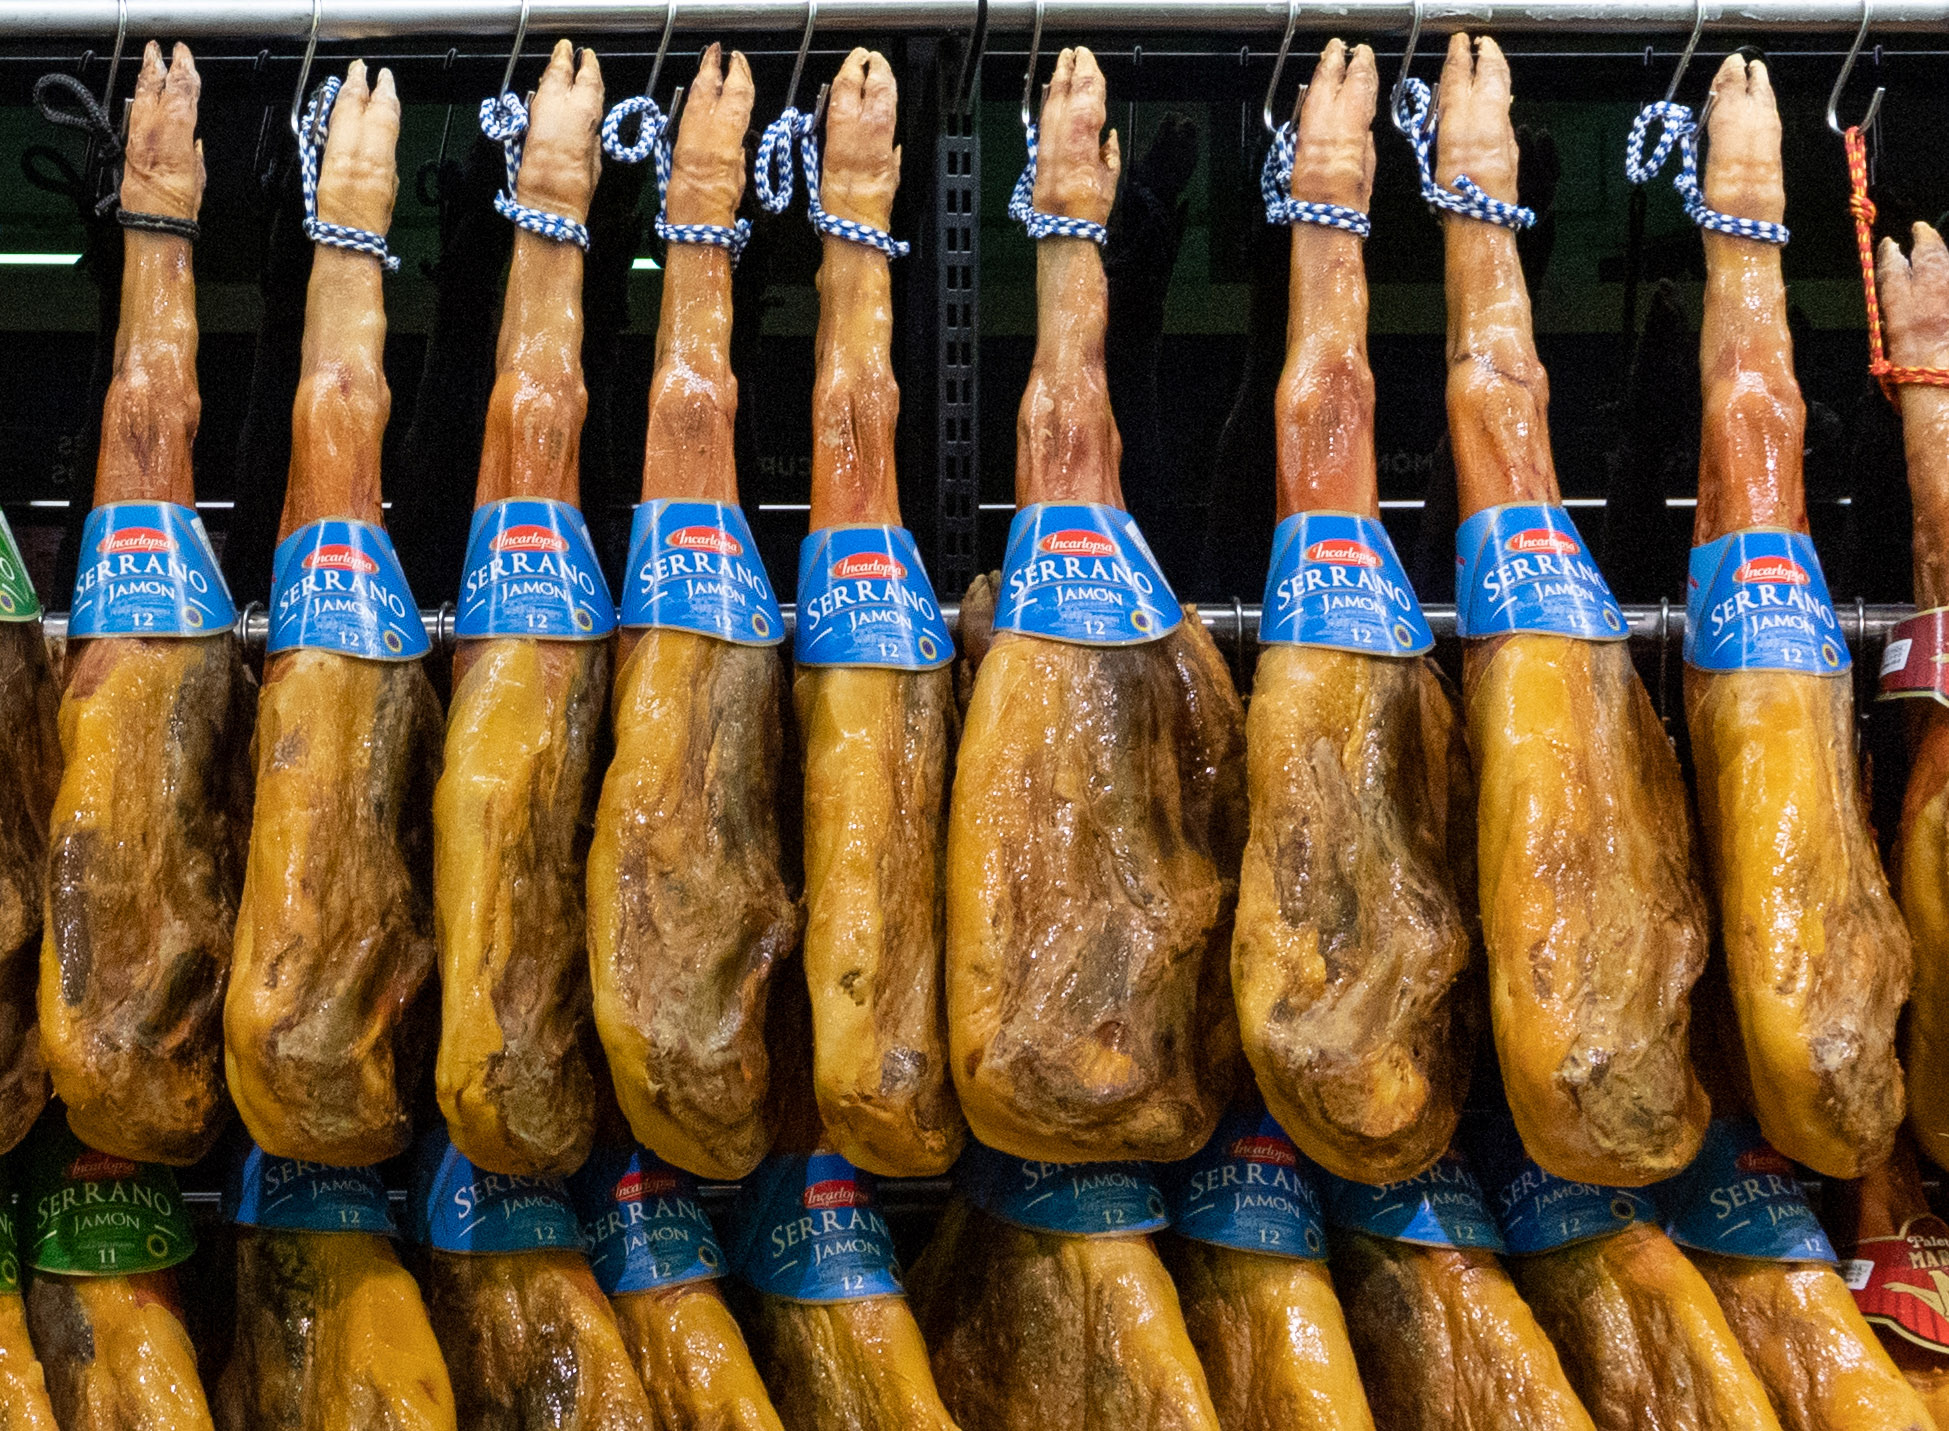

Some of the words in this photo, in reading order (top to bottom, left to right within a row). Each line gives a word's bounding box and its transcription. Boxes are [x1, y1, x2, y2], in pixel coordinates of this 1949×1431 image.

[499, 531, 563, 549] Incarlopsa
[1047, 534, 1113, 554] Incarlopsa
[1313, 543, 1377, 565] Incarlopsa
[639, 551, 767, 601] SERRANO
[838, 558, 902, 577] Incarlopsa
[75, 554, 208, 605] SERRANO
[466, 552, 595, 603] SERRANO
[1009, 556, 1153, 599] SERRANO
[1483, 554, 1611, 602] SERRANO
[279, 569, 405, 620] SERRANO
[1277, 565, 1411, 611] SERRANO
[806, 580, 935, 630] SERRANO
[1711, 584, 1835, 636] SERRANO
[132, 613, 154, 626] 12
[525, 614, 548, 628] 12
[713, 614, 733, 631] 12
[1083, 620, 1106, 635] 12
[1567, 614, 1589, 629] 12
[338, 631, 360, 647] 12
[1350, 628, 1373, 643] 12
[878, 643, 899, 657] 12
[1781, 648, 1803, 663] 12
[37, 1180, 171, 1230] SERRANO
[338, 1210, 360, 1224] 12
[1101, 1208, 1125, 1225] 12
[534, 1226, 557, 1241] 12
[1454, 1224, 1476, 1241] 12
[1559, 1217, 1581, 1236] 12
[1259, 1227, 1281, 1245] 12
[1802, 1237, 1824, 1252] 12
[98, 1248, 116, 1264] 11
[650, 1262, 672, 1280] 12
[841, 1273, 865, 1290] 12
